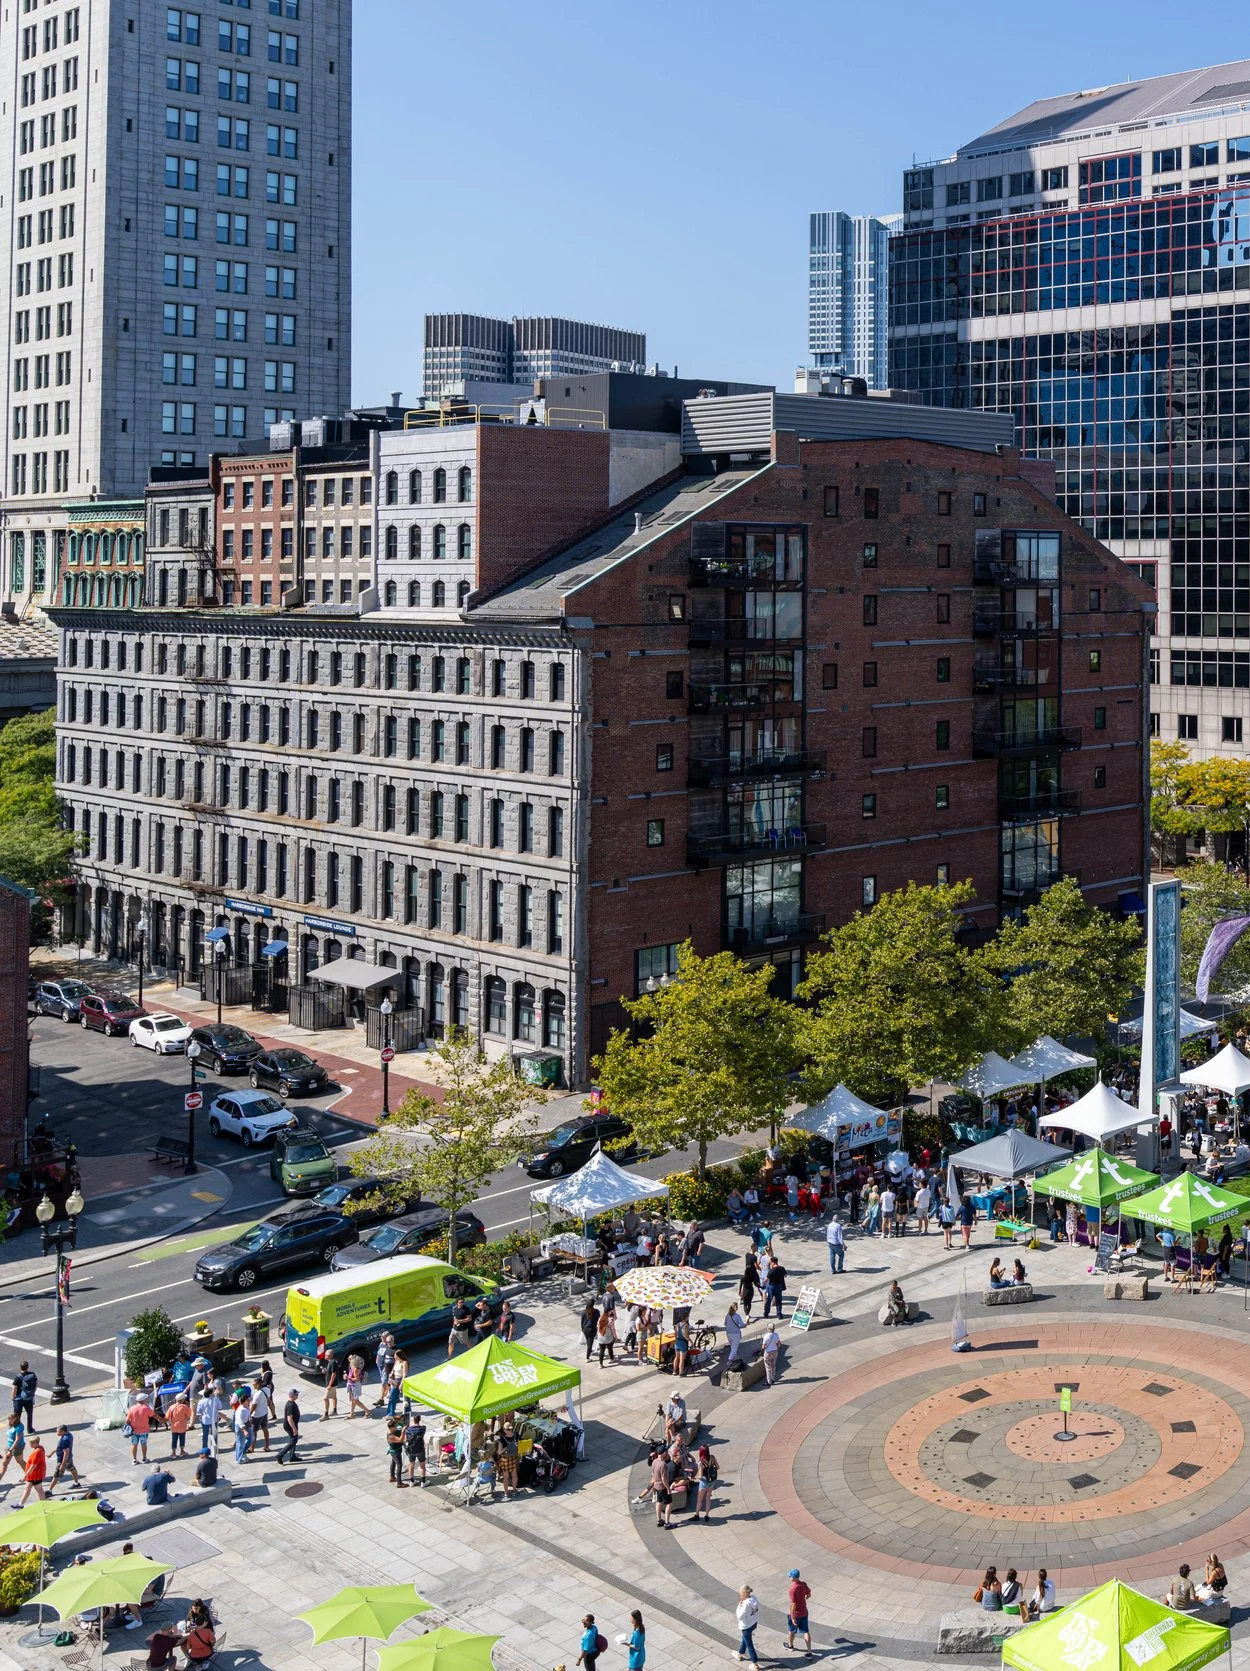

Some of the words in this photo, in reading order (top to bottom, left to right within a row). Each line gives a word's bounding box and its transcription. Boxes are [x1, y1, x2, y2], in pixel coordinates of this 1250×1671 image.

[230, 902, 256, 912] HARBORSIDE
[305, 918, 333, 929] HARBORSIDE
[333, 923, 352, 933] LOUNGE
[1048, 1185, 1082, 1202] trustees
[1115, 1183, 1146, 1201] trustees
[1138, 1209, 1173, 1227] trustees
[1208, 1208, 1239, 1225] trustees
[336, 1302, 356, 1312] MOBILE
[336, 1303, 371, 1318] ADVENTURES
[356, 1309, 377, 1320] trustees
[482, 1378, 571, 1416] RoseKennedyGreenway.org
[1144, 1618, 1174, 1641] GREENWAY
